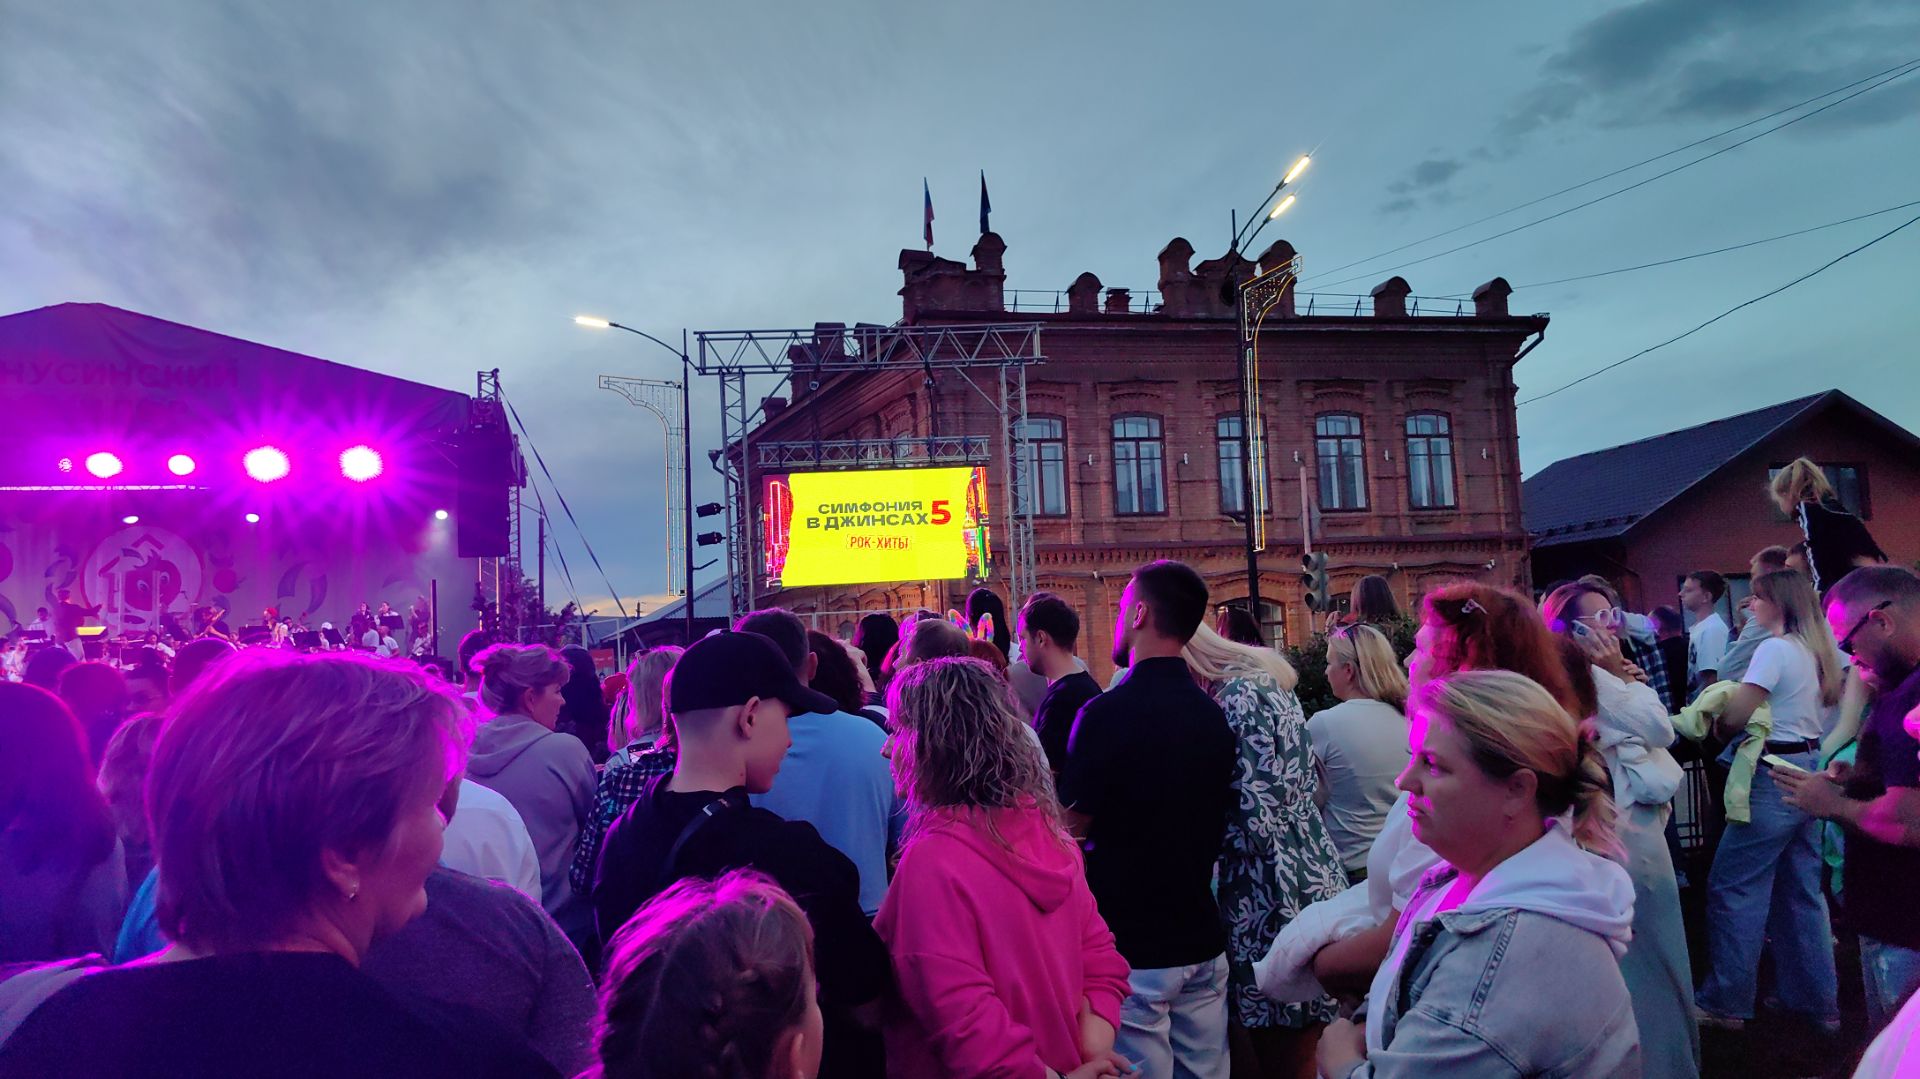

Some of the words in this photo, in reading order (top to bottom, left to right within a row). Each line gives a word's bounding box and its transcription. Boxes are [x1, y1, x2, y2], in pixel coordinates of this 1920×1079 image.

[818, 500, 922, 514] СИМФОНИЯ
[931, 500, 951, 525] 5
[806, 517, 820, 529] В
[824, 513, 929, 531] ДЖИНСАХ
[850, 536, 909, 549] РОК-ХИТЫ
